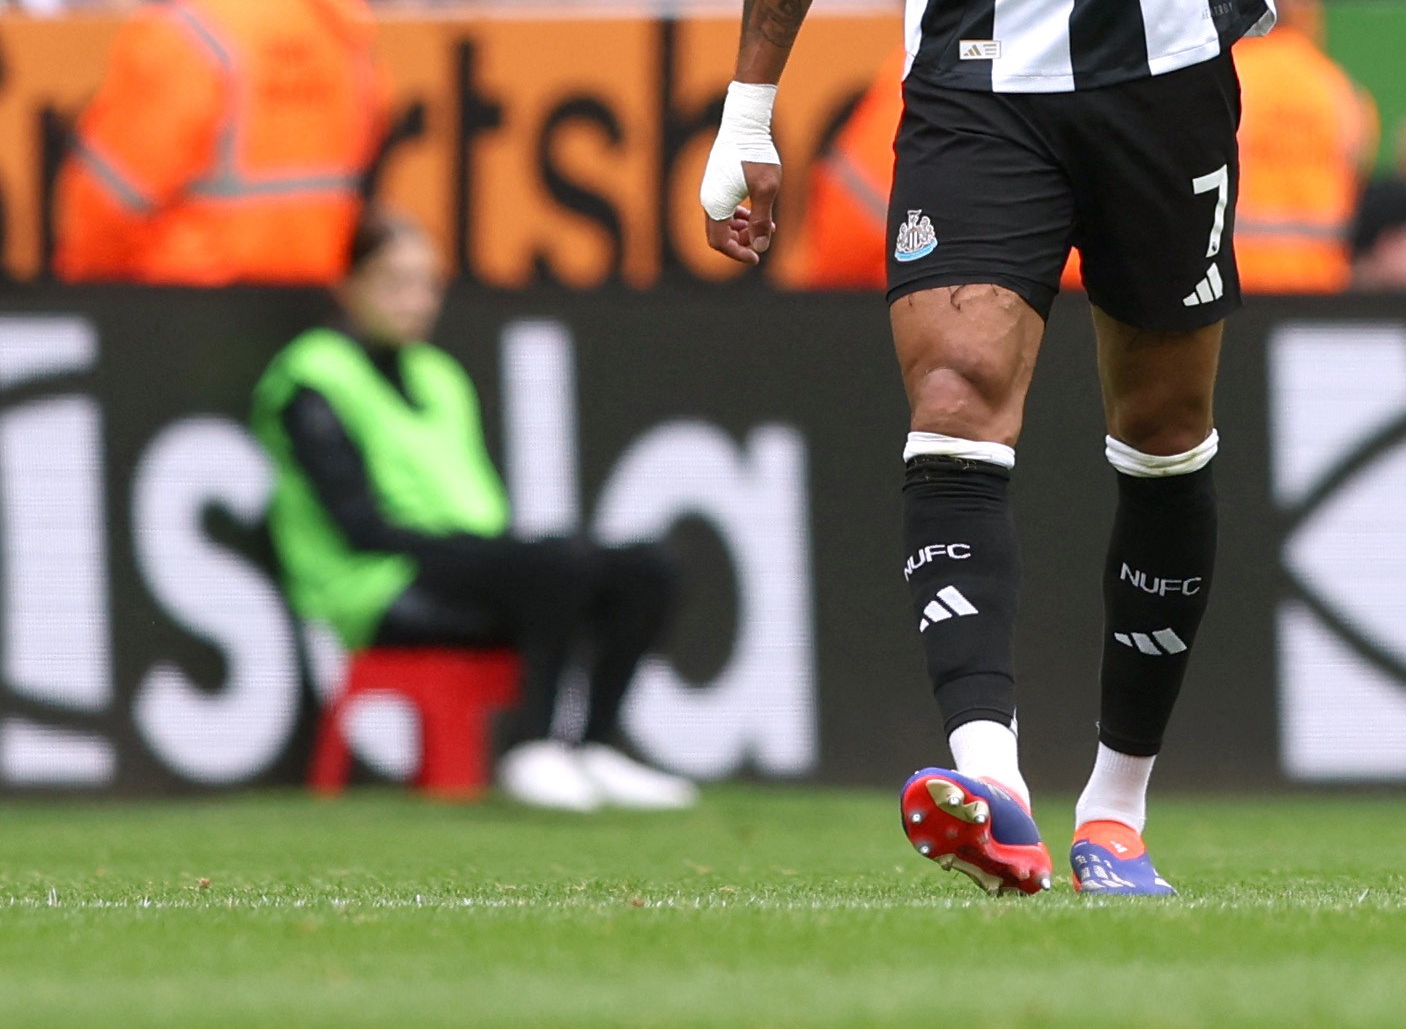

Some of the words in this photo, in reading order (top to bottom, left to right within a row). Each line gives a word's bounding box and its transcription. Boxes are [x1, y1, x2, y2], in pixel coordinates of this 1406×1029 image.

[1192, 164, 1228, 258] 7
[130, 317, 819, 785] sla
[903, 543, 971, 581] NUFC
[1119, 562, 1202, 596] NUFC
